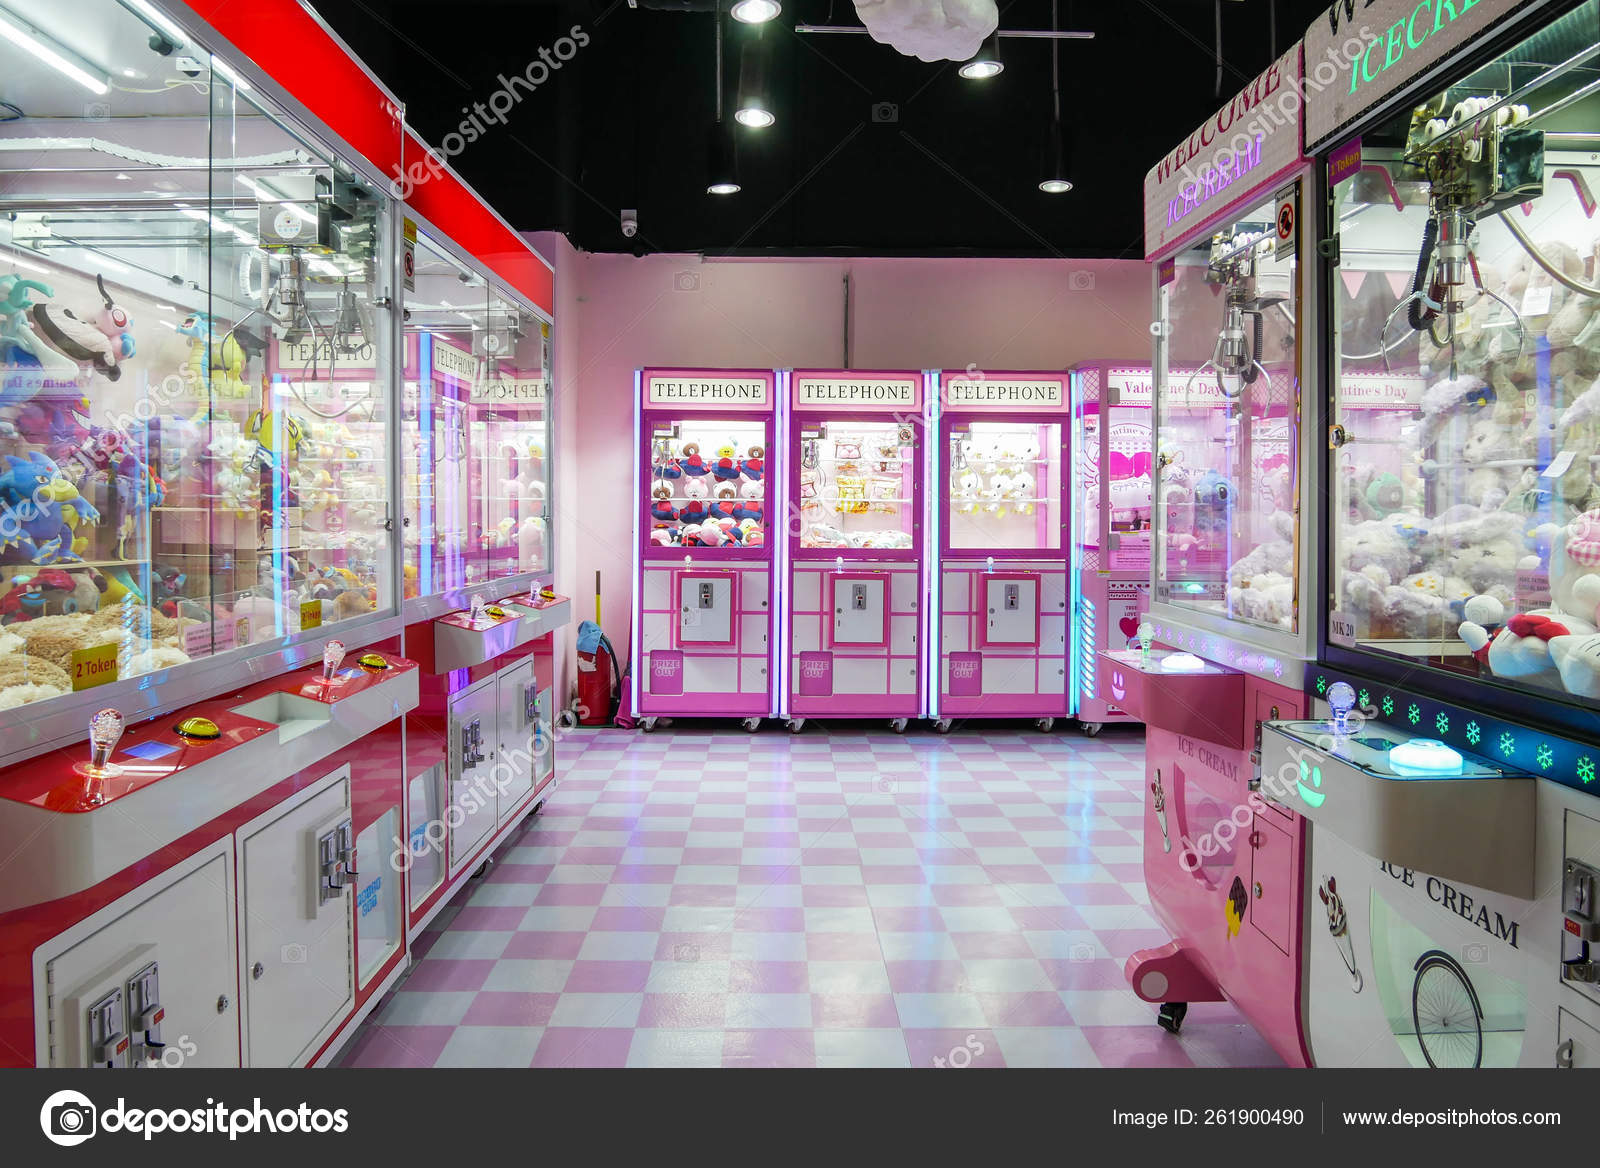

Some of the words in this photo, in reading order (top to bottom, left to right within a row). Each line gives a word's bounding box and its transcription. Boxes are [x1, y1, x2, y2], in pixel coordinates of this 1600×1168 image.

[1157, 65, 1281, 184] WELCOME
[1337, 152, 1360, 171] Token
[1166, 131, 1264, 228] ICECREAM
[655, 383, 761, 398] TELEPHONE
[804, 384, 910, 399] TELEPHONE
[953, 385, 1057, 400] TELEPHONE
[1199, 382, 1221, 397] Day
[1385, 384, 1408, 399] Day
[1332, 620, 1345, 636] MK
[1345, 623, 1354, 637] 20
[76, 663, 83, 678] 2
[86, 657, 117, 676] Token
[655, 667, 675, 677] OUT
[804, 668, 824, 678] OUT
[953, 668, 973, 678] OUT
[1177, 735, 1194, 758] ICE
[1198, 747, 1239, 782] CREAM
[1380, 861, 1415, 888] ICE
[1426, 876, 1520, 949] CREAM
